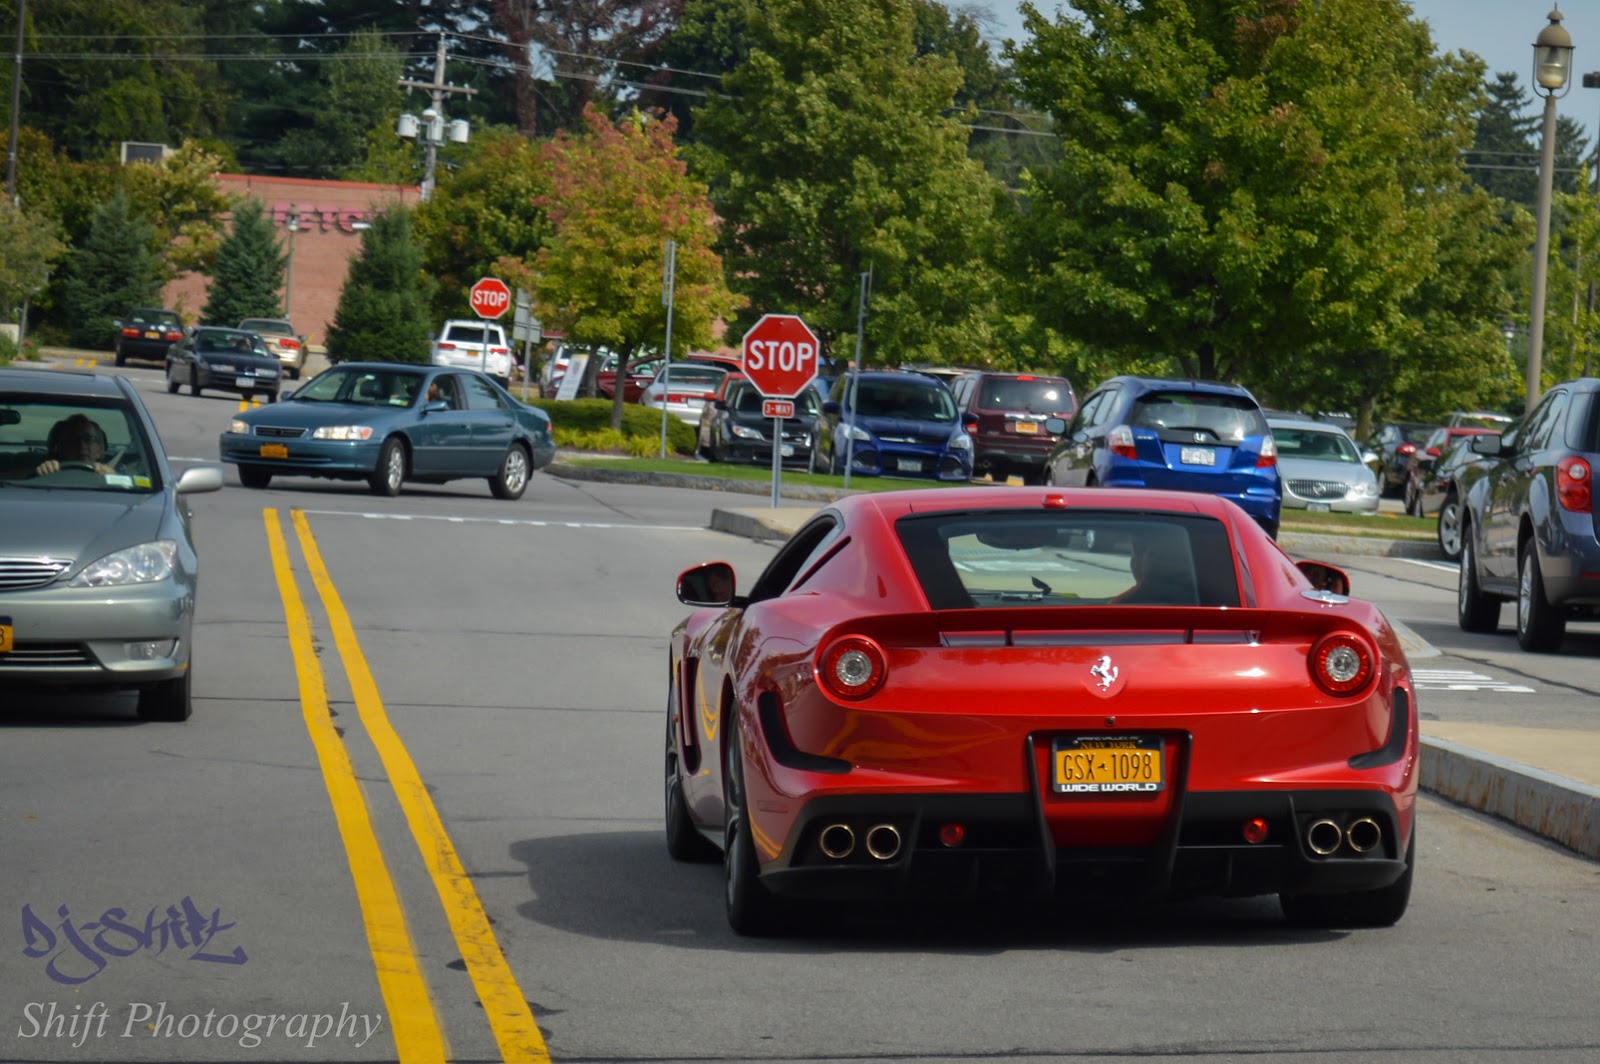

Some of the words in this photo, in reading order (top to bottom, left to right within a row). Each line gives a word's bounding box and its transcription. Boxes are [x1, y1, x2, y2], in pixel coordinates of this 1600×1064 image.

[473, 289, 508, 307] STOP
[748, 340, 814, 372] STOP
[765, 403, 793, 415] 3-WAY
[1080, 740, 1106, 750] NEW
[1108, 740, 1137, 749] YORK
[1061, 783, 1100, 792] WIDE
[1101, 783, 1157, 792] WORLD
